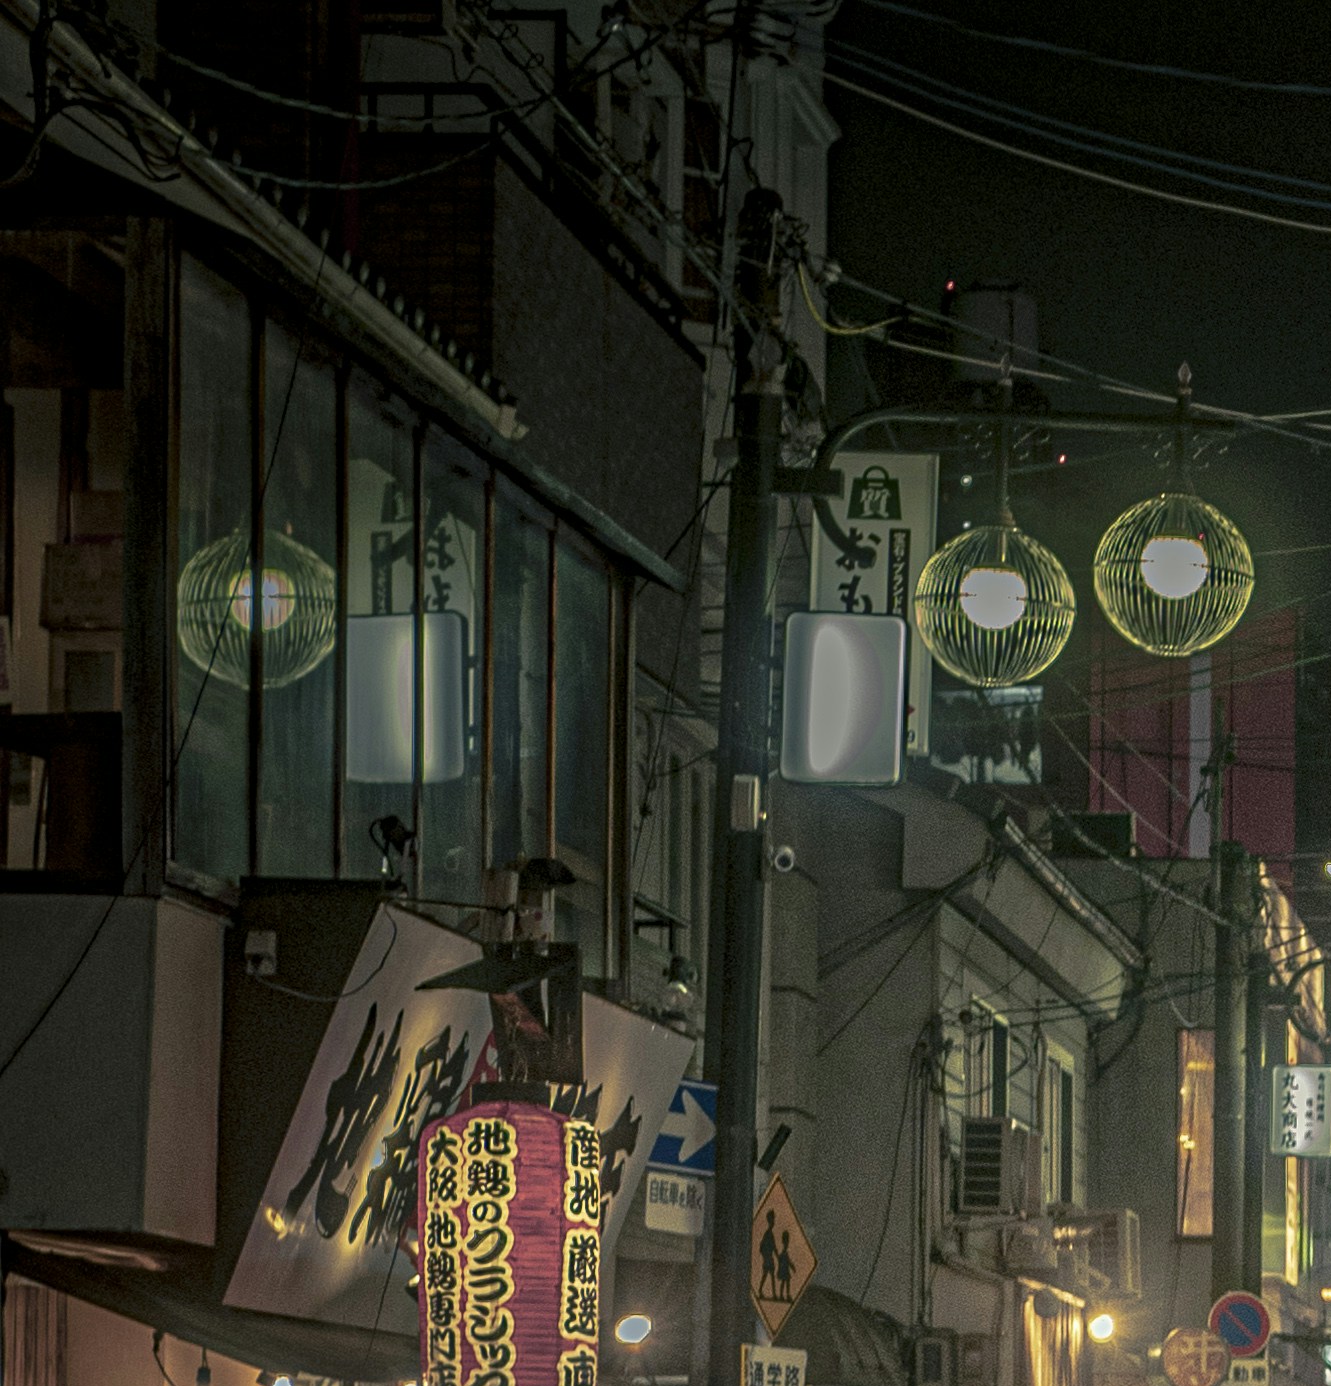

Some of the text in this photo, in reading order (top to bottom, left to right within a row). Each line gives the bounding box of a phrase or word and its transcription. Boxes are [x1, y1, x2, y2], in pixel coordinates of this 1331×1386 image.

[1281, 1072, 1299, 1149] 丸大商店
[570, 1125, 600, 1221] 産地
[1230, 1365, 1266, 1381] 動車
